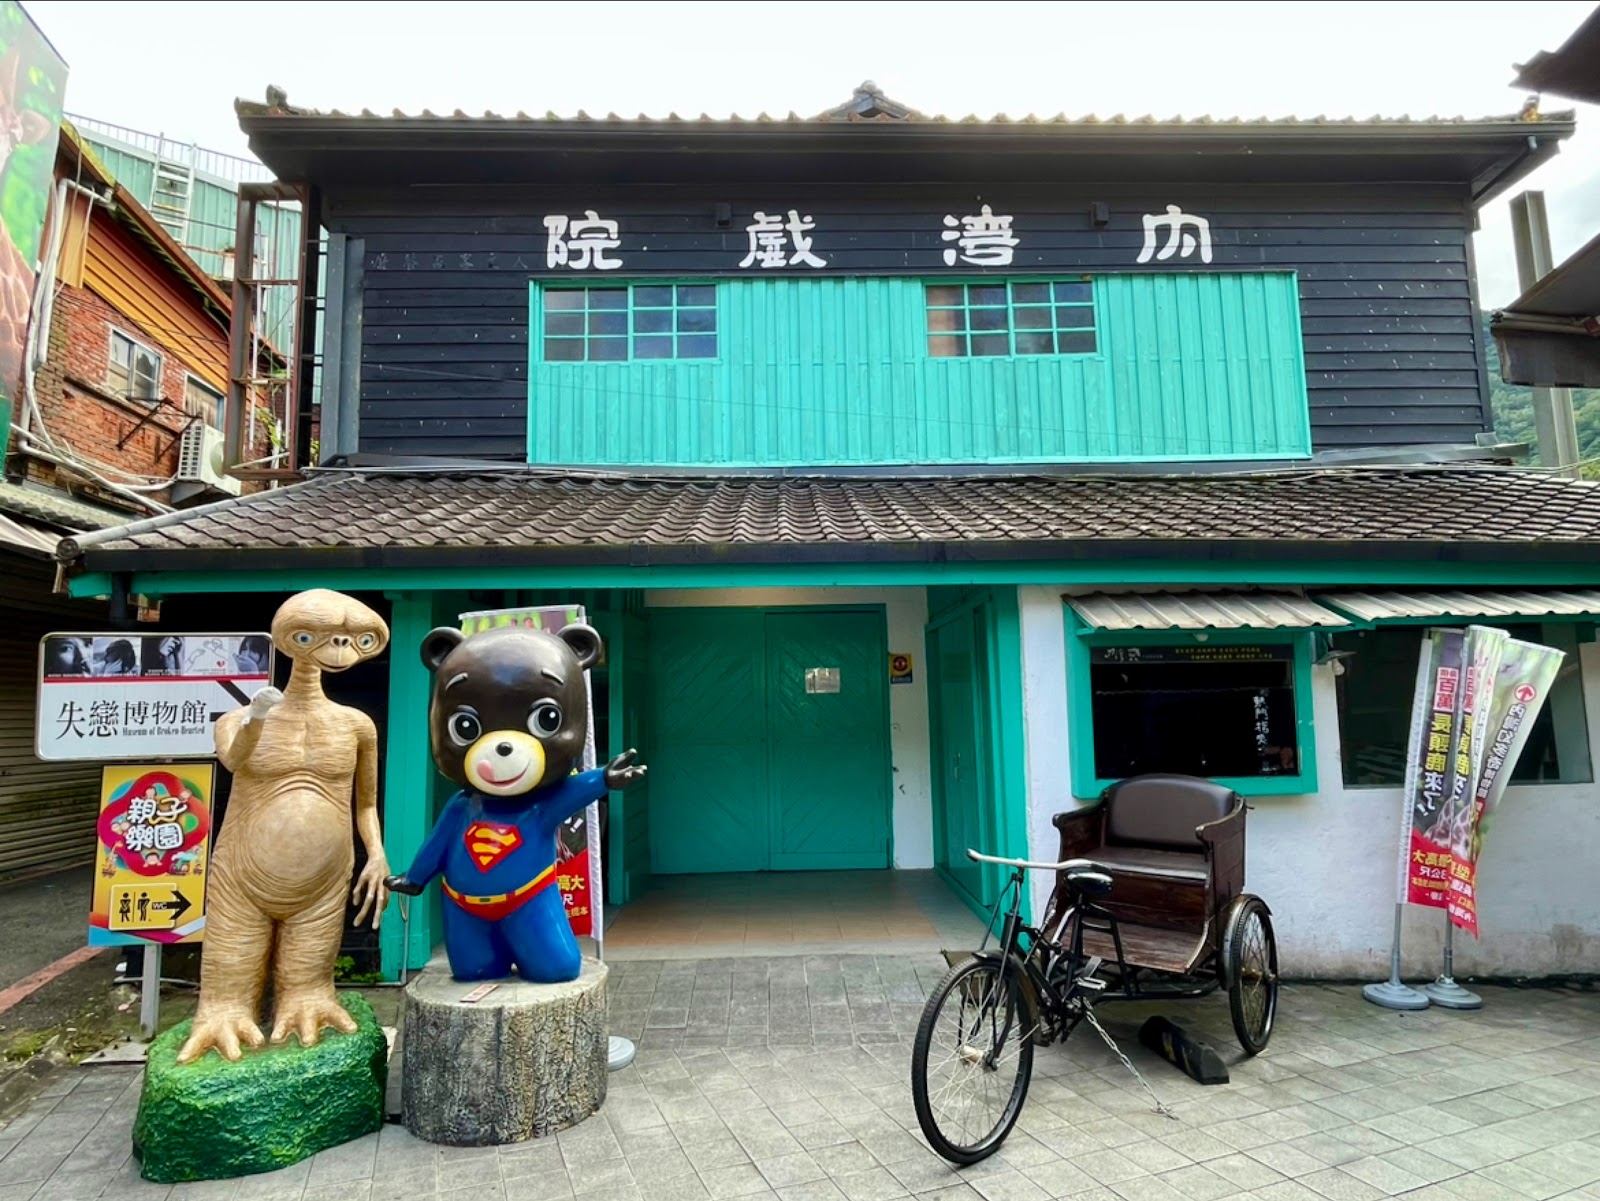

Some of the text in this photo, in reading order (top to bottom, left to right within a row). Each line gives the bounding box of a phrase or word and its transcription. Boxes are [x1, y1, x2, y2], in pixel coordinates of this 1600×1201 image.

[56, 700, 207, 740] 失戀博物館
[122, 727, 148, 736] Museum
[149, 727, 156, 735] of
[127, 796, 188, 824] 親子
[126, 823, 184, 851] 樂園
[152, 902, 168, 910] WC
